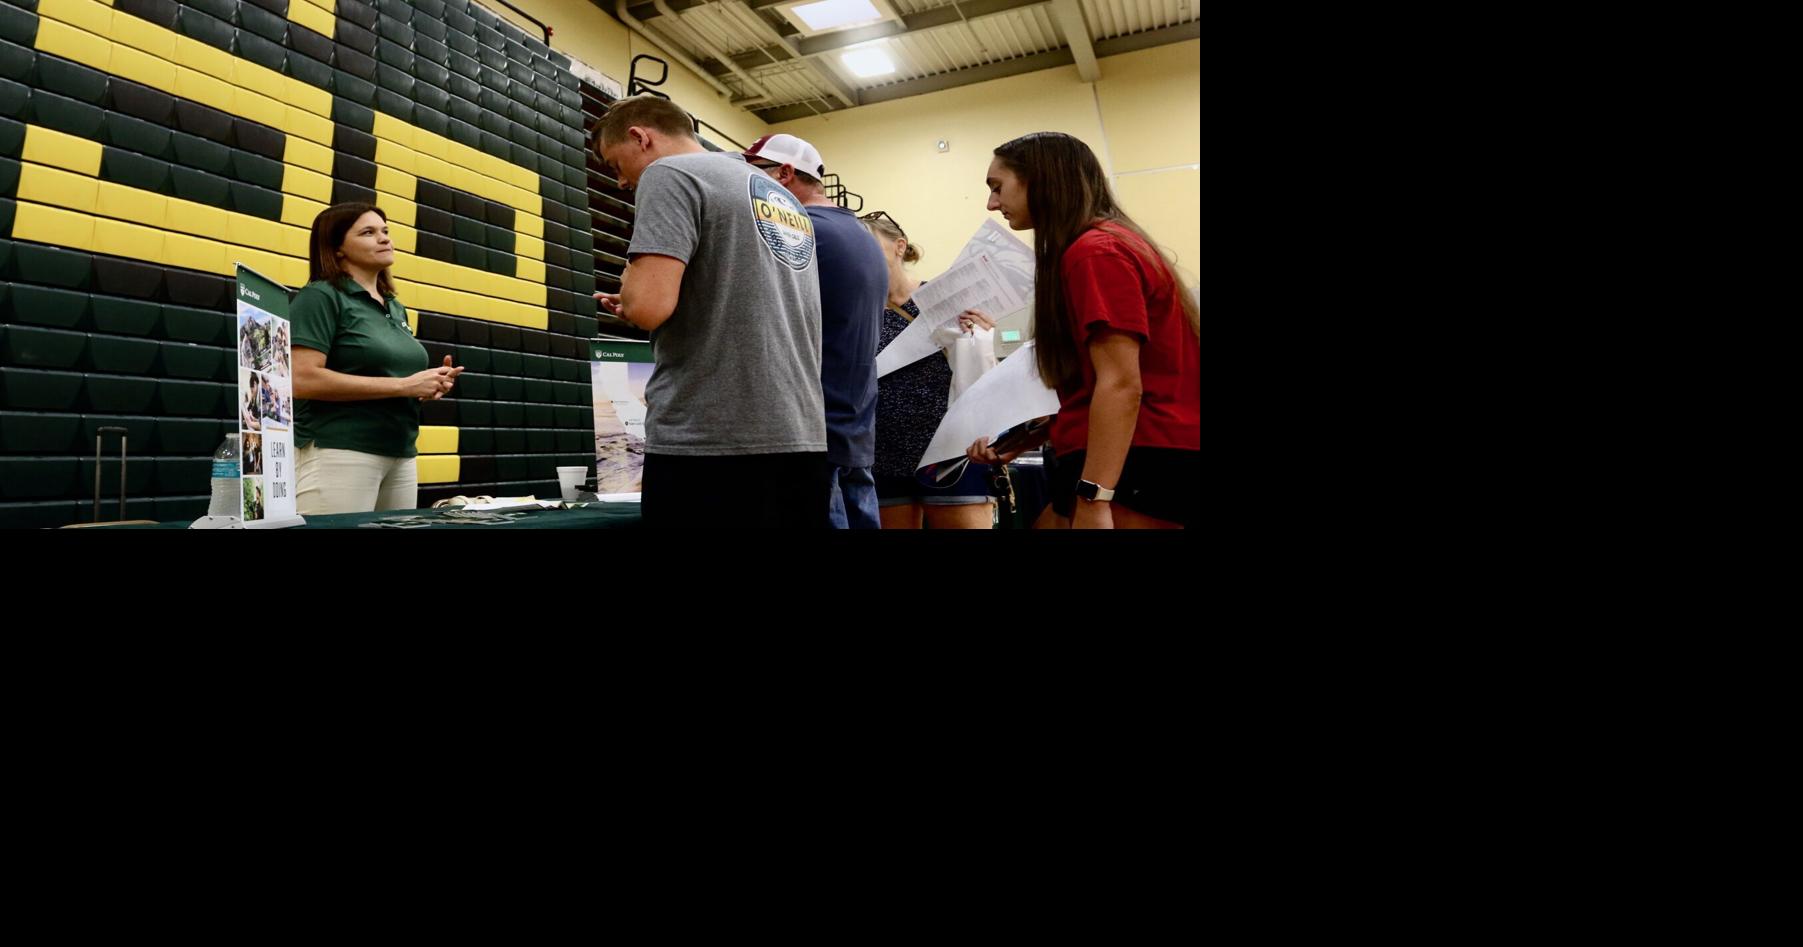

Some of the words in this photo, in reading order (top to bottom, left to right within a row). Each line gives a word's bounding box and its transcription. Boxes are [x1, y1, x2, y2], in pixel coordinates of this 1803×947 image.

[760, 202, 810, 233] O'NEILL
[270, 441, 286, 458] LEARN
[275, 461, 282, 478] BY
[272, 481, 287, 498] DOING
